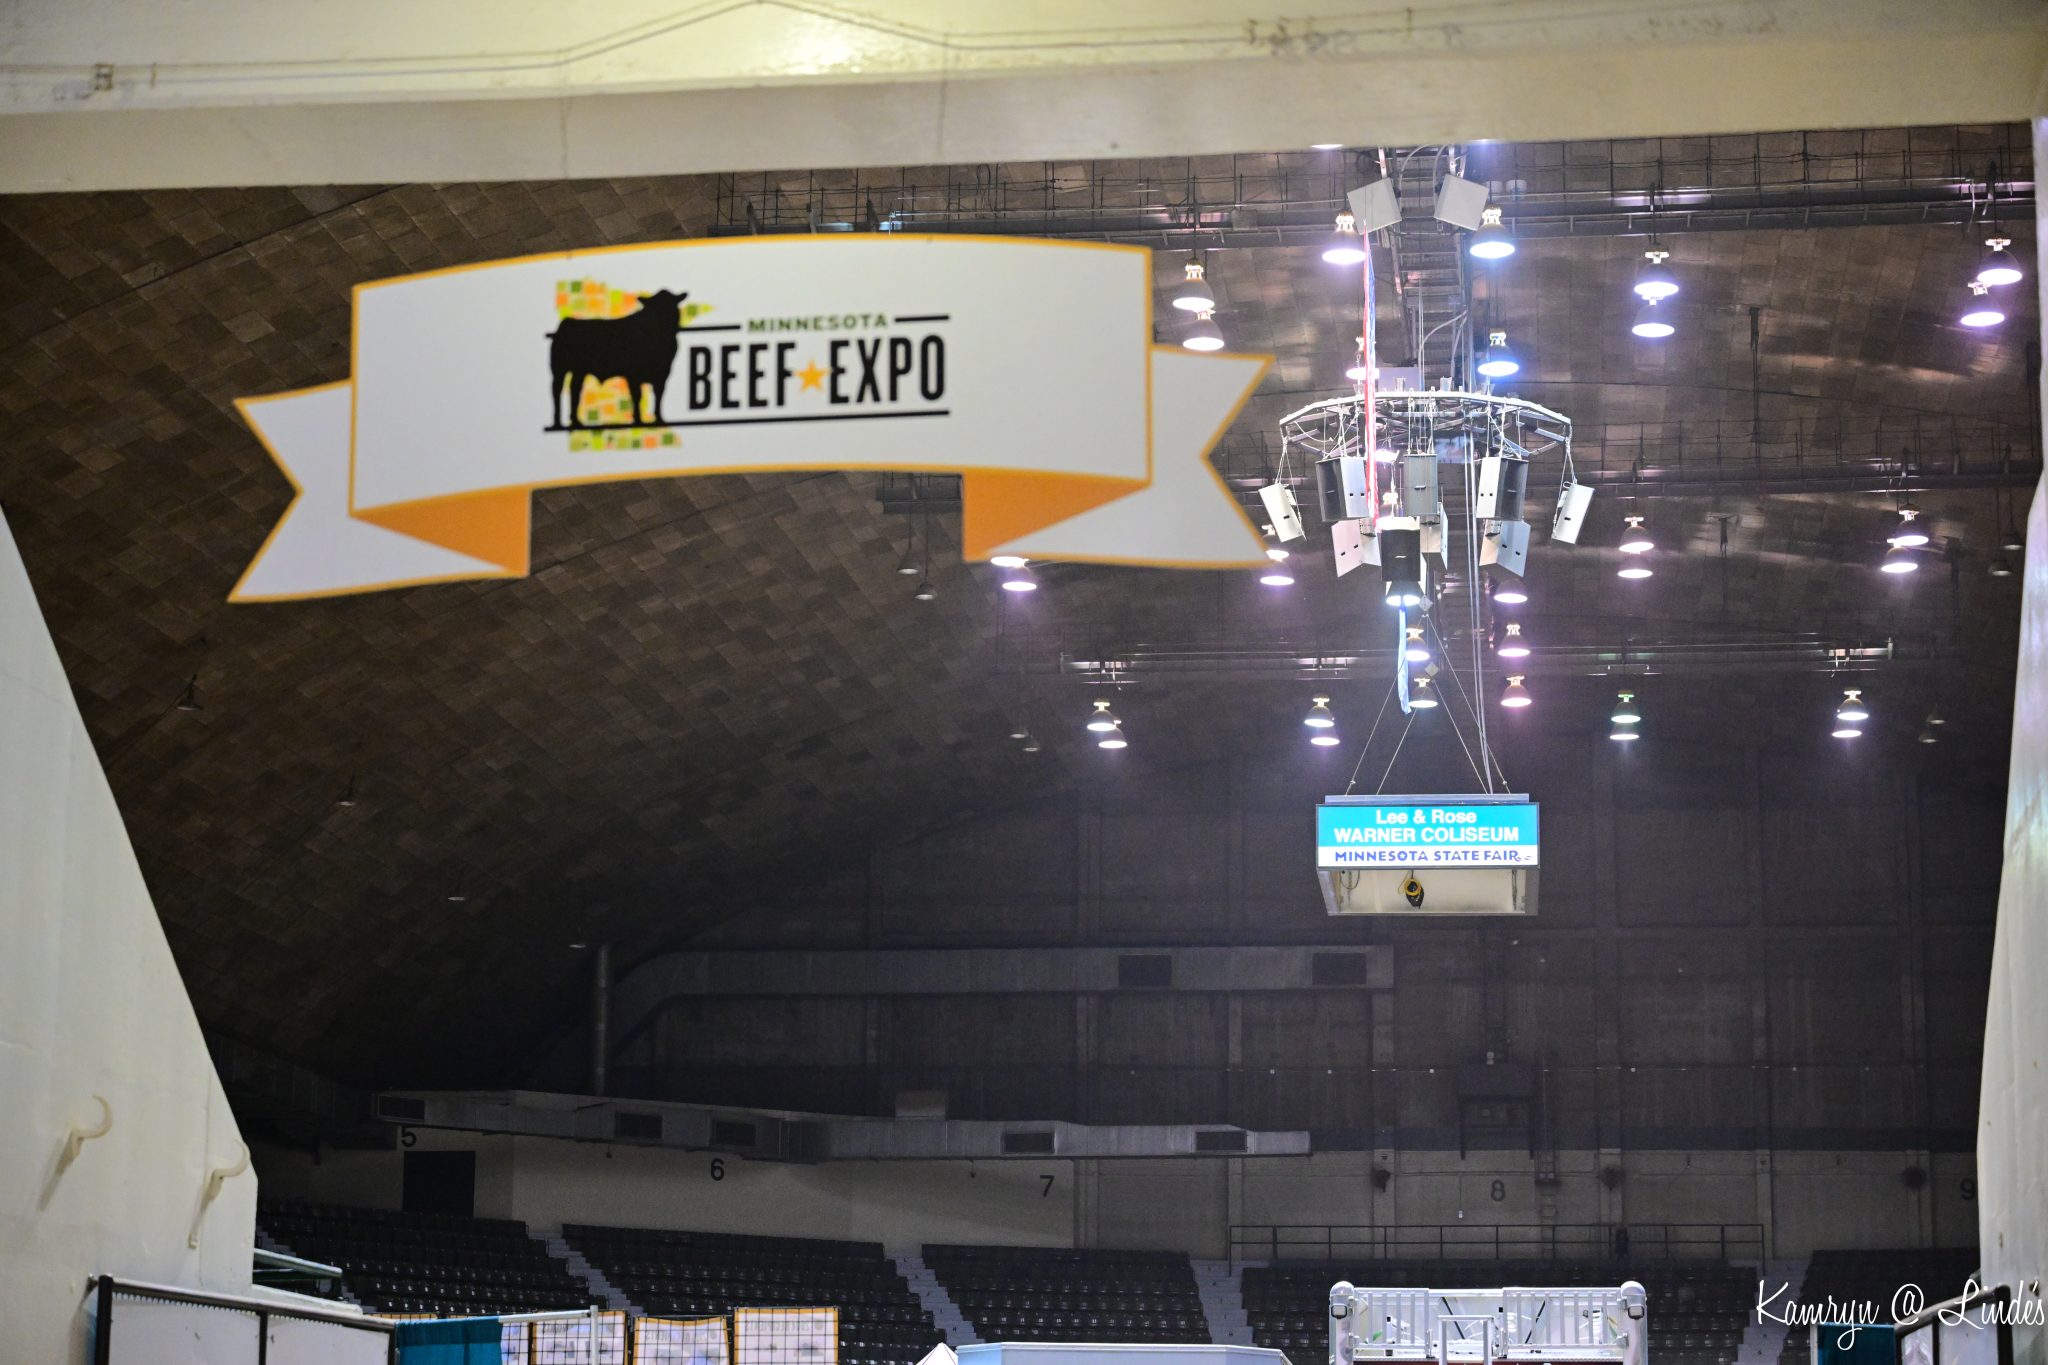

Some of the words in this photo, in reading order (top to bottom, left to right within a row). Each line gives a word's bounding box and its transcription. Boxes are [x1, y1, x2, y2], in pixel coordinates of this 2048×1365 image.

[749, 314, 888, 332] MINNESOTA
[688, 342, 795, 411] BEEF
[829, 334, 945, 404] EXPO
[1376, 809, 1408, 824] Lee
[1413, 809, 1426, 824] &
[1431, 809, 1477, 824] Rose
[1334, 828, 1416, 842] WARNER
[1421, 827, 1519, 842] COLISEUM
[1335, 851, 1428, 862] MINNESOTA
[1434, 850, 1479, 861] STATE
[1484, 850, 1521, 862] FAIR
[401, 1128, 417, 1147] 5
[710, 1158, 725, 1181] 6
[1039, 1175, 1055, 1198] 7
[1490, 1180, 1506, 1202] 8
[1961, 1179, 1975, 1200] 9
